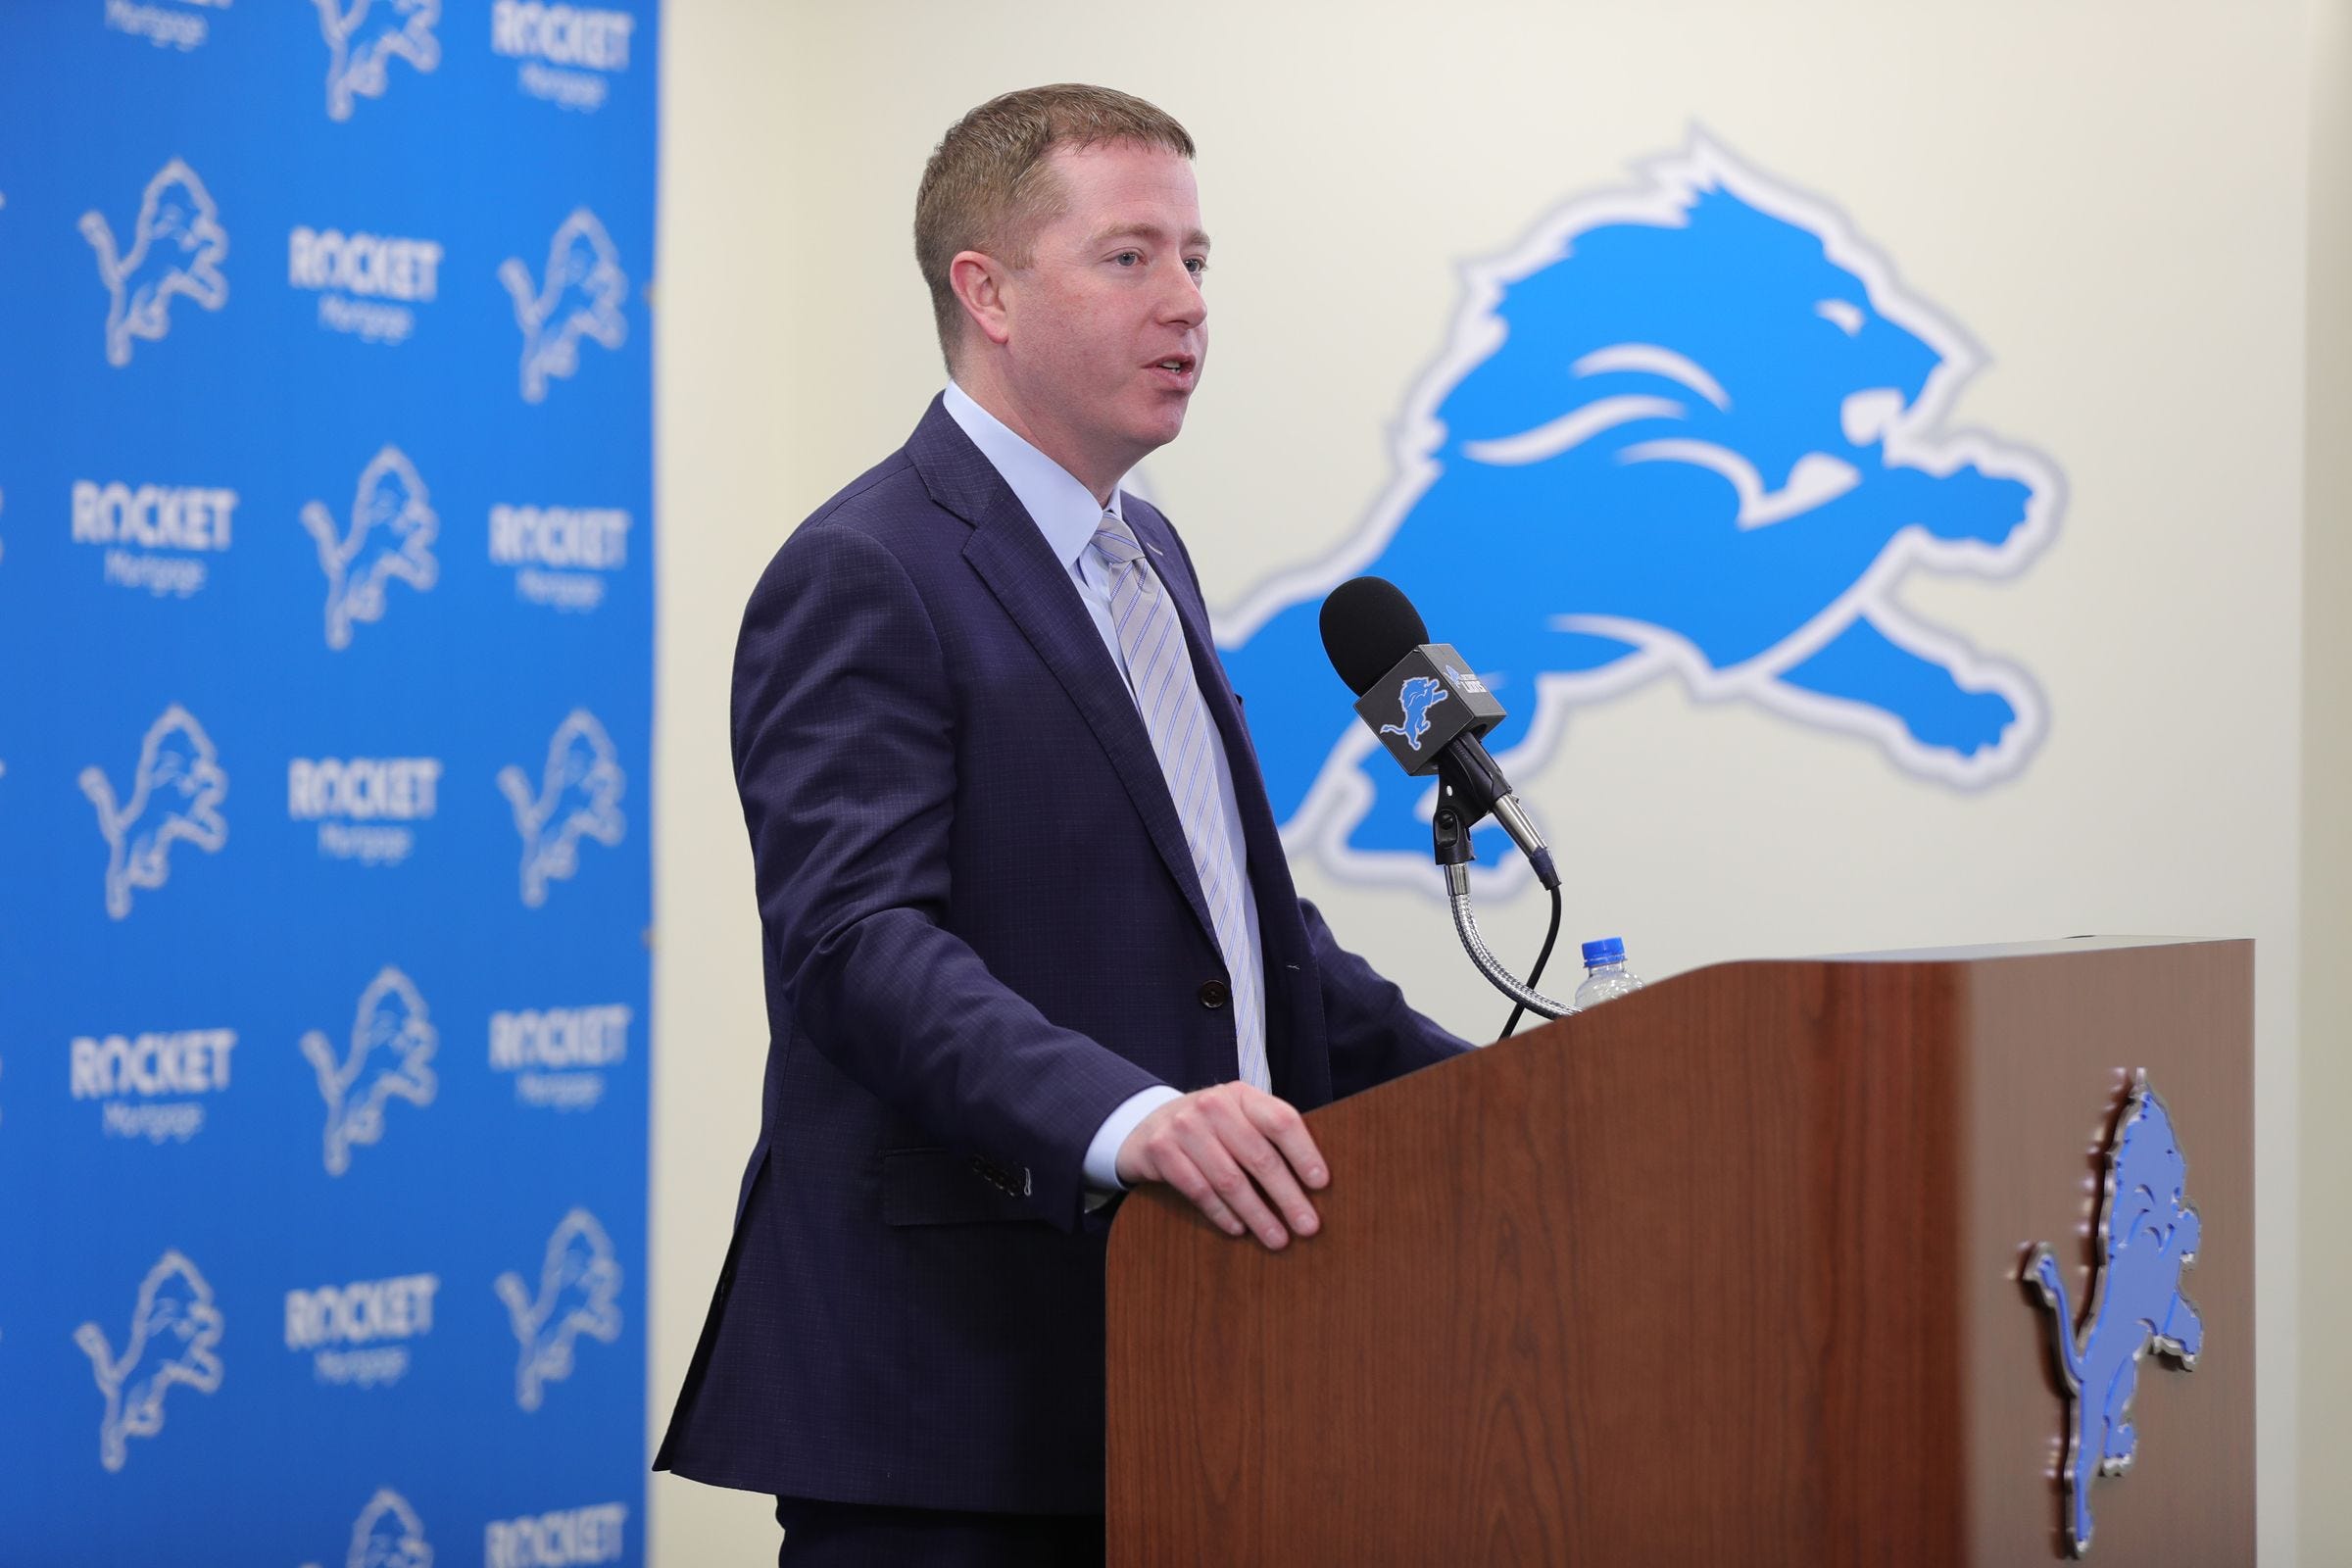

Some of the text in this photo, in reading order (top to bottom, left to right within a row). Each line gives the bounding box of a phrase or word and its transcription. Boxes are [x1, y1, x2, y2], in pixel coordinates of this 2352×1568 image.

[492, 0, 633, 71] ROCKET
[290, 227, 442, 302] ROCKET
[73, 481, 237, 550] ROCKET
[490, 505, 630, 570] ROCKET
[289, 759, 441, 819] ROCKET
[72, 1029, 236, 1097] ROCKET
[490, 1004, 630, 1068] ROCKET
[286, 1274, 438, 1349] ROCKET
[486, 1503, 627, 1568] ROCKET
